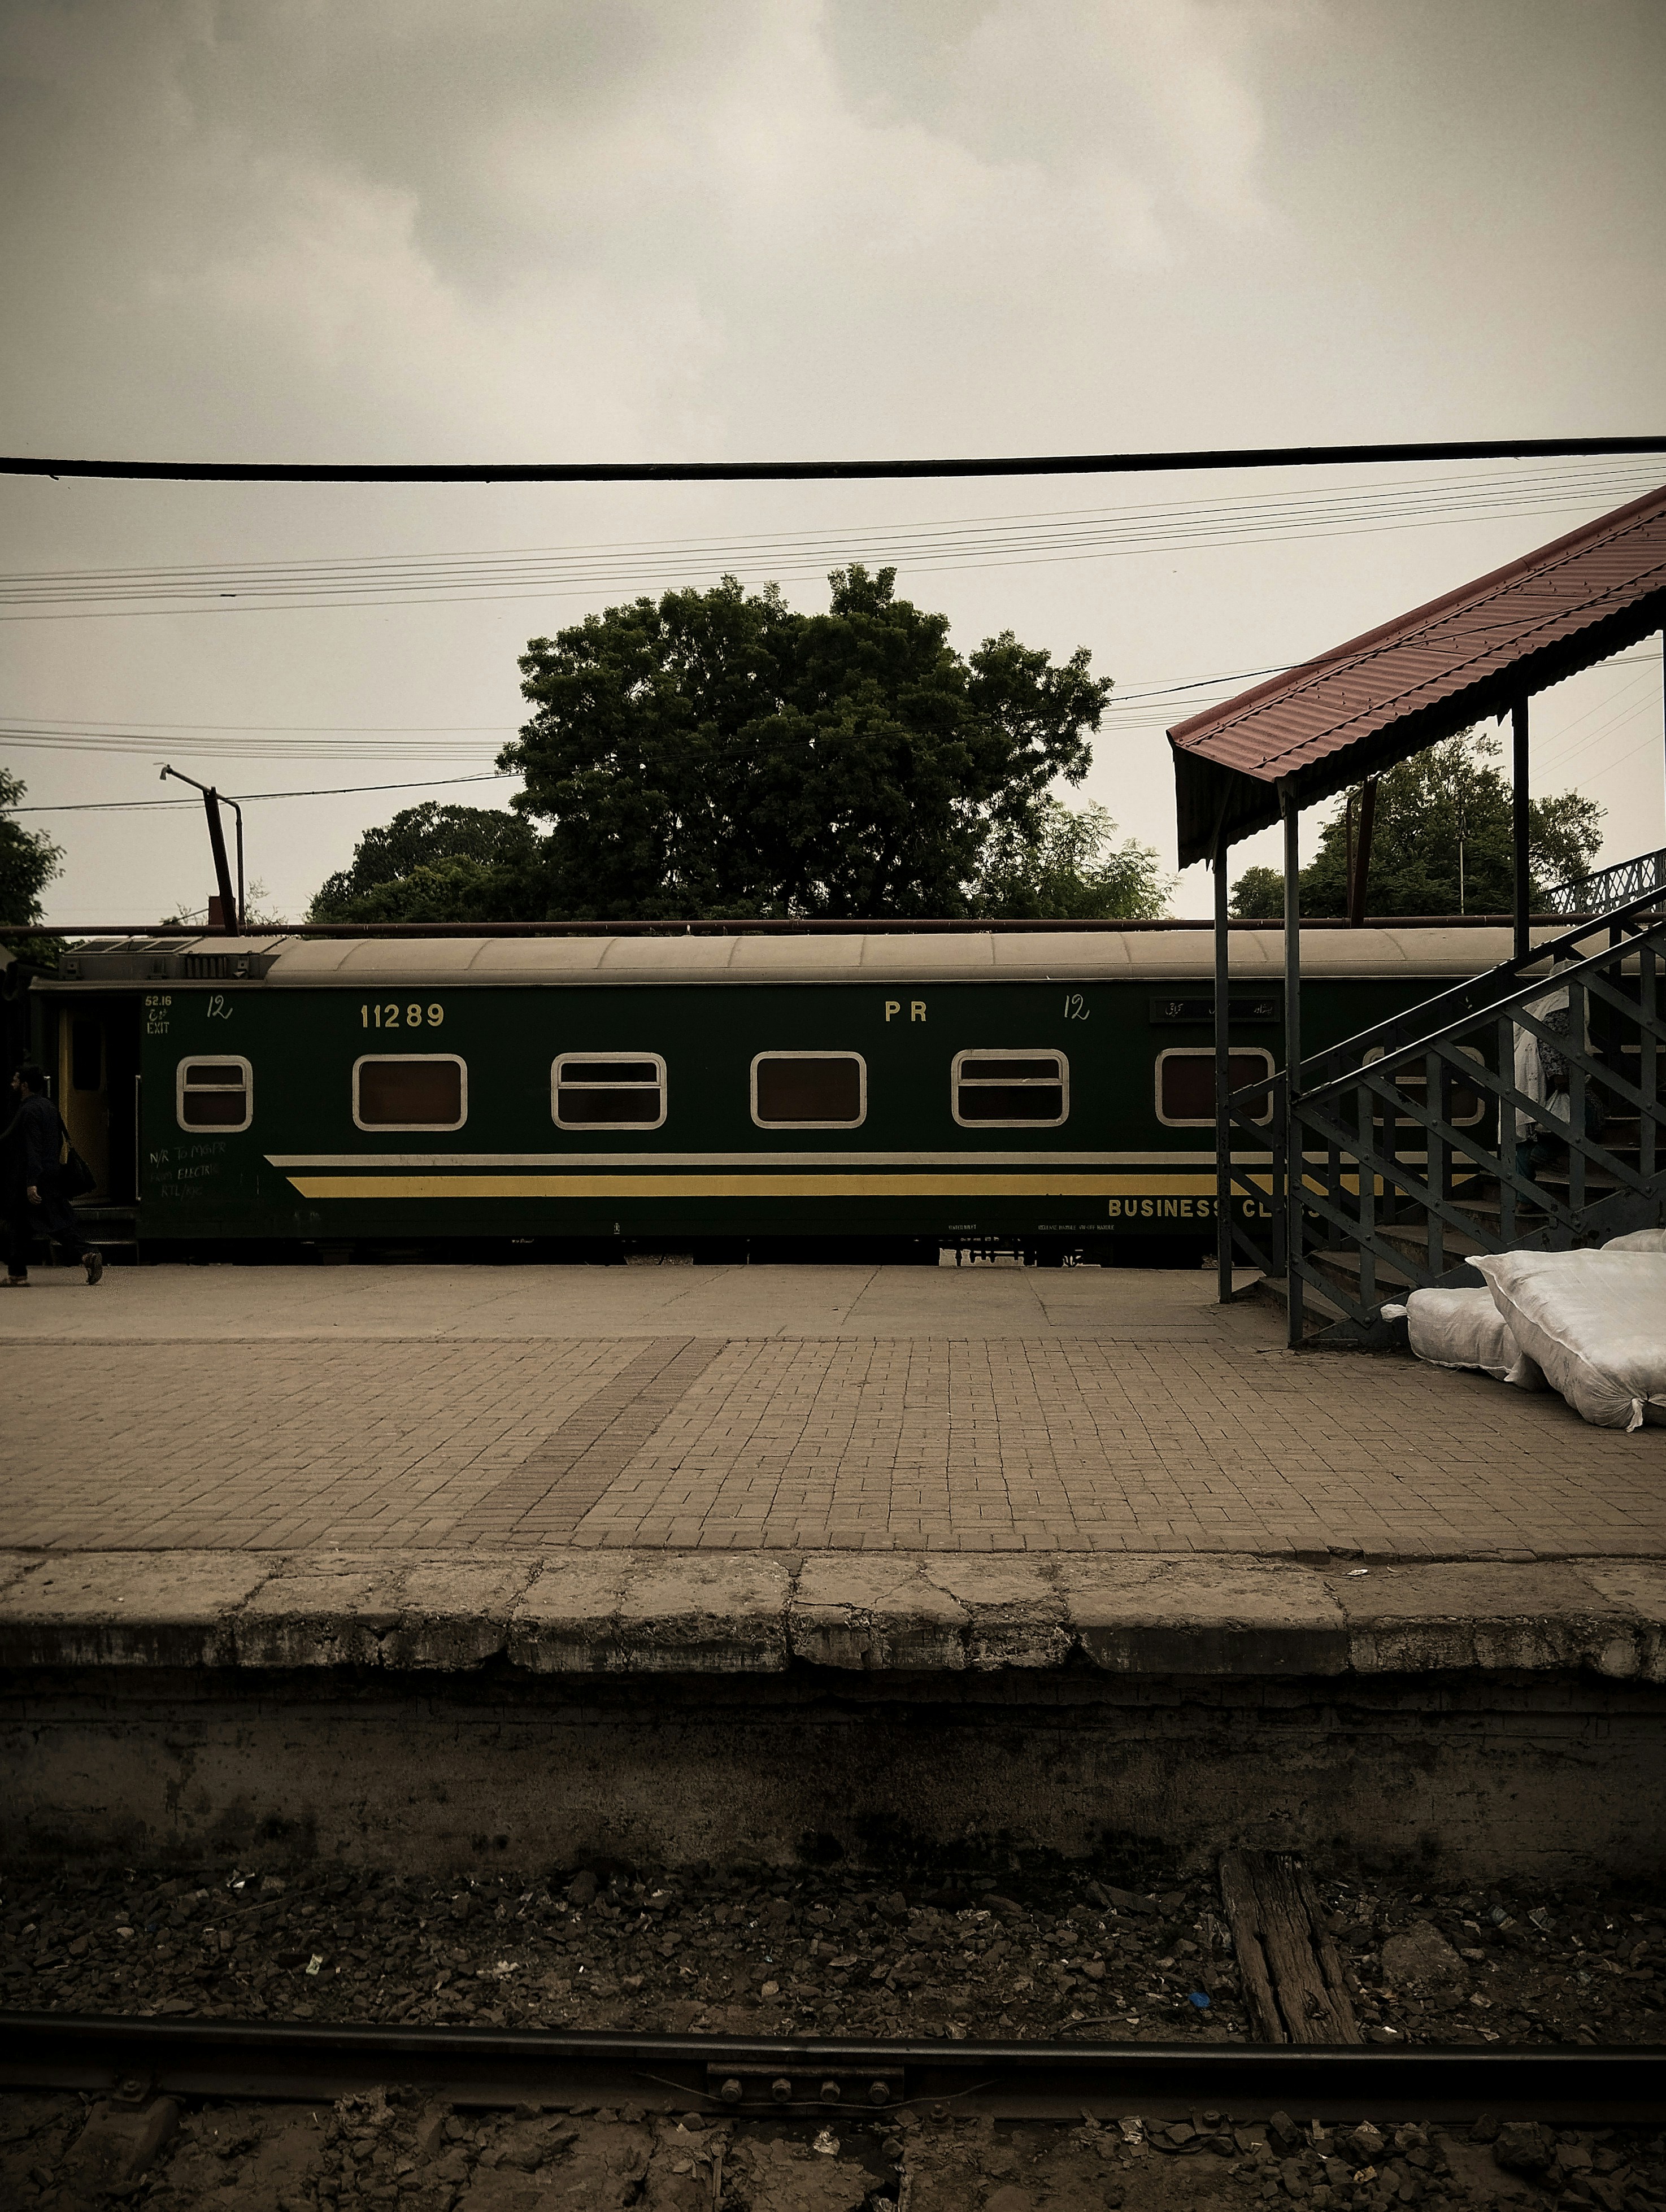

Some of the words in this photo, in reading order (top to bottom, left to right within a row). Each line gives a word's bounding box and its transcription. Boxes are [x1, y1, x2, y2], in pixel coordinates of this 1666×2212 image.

[207, 994, 233, 1020] 12
[361, 1003, 444, 1028] 11289
[1064, 994, 1090, 1020] 12
[147, 1021, 169, 1034] EXIT
